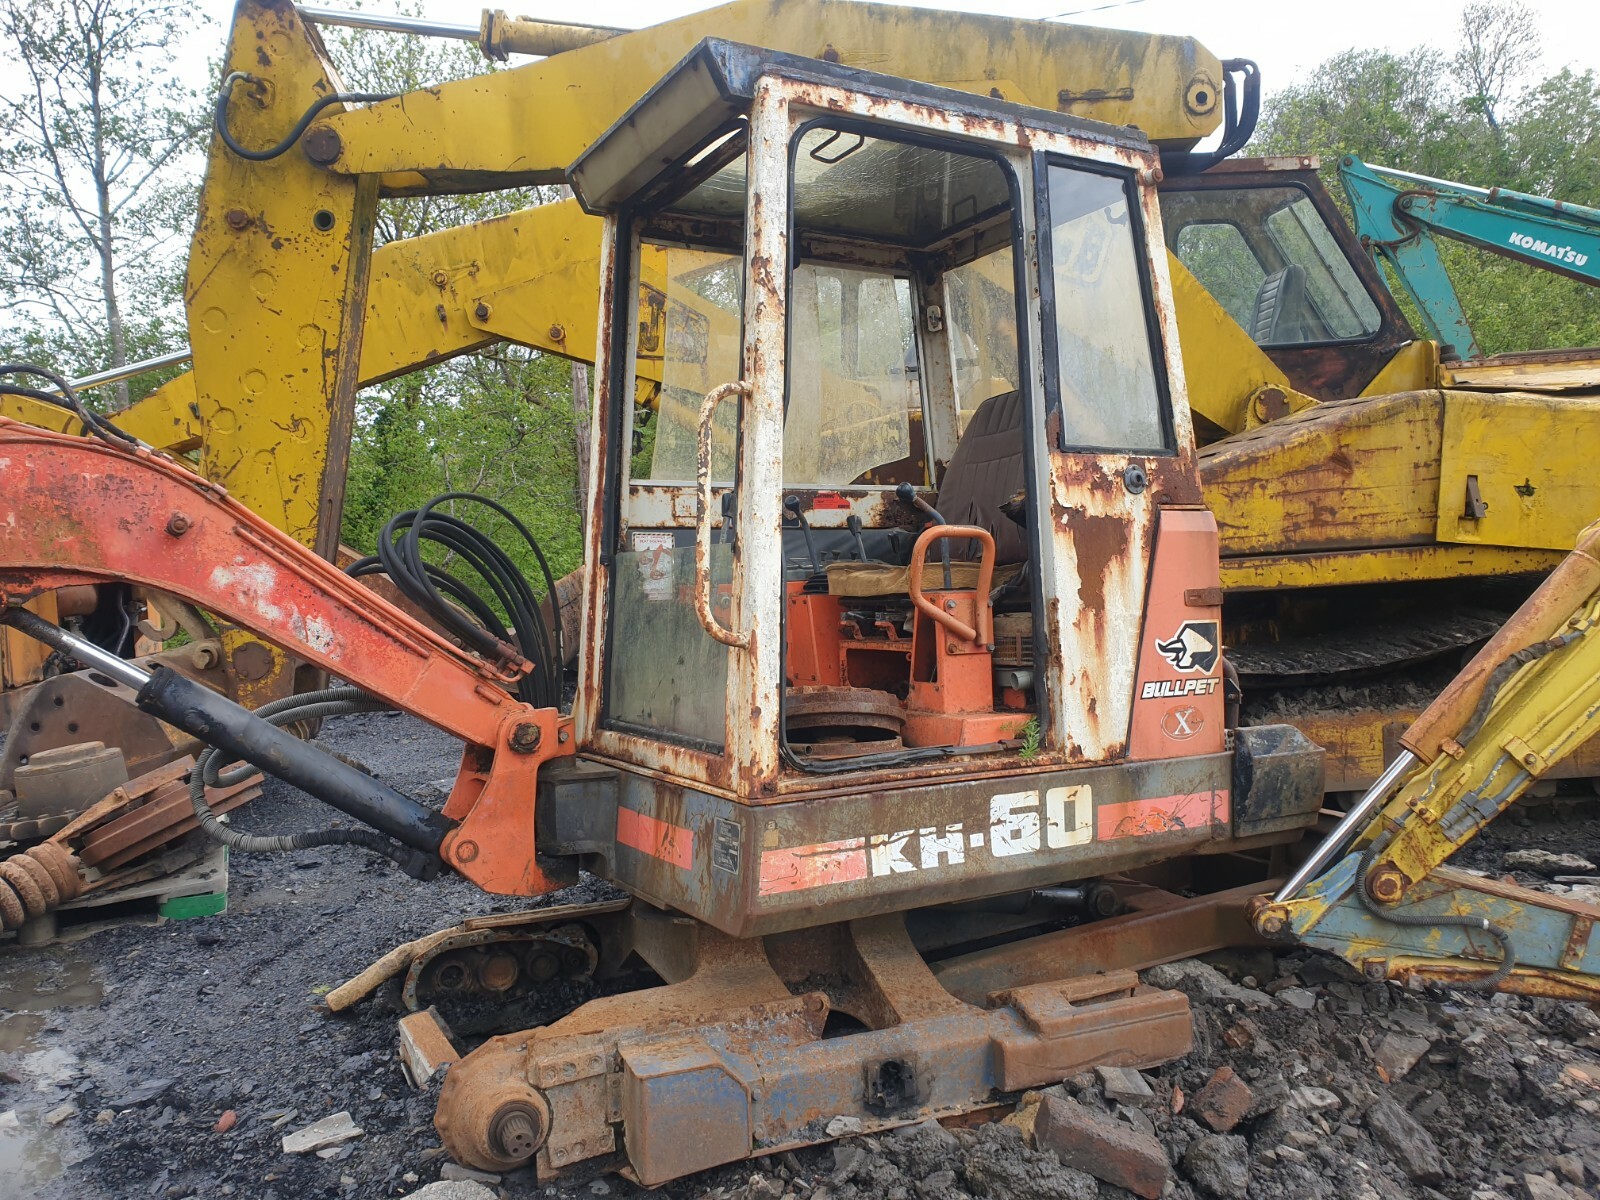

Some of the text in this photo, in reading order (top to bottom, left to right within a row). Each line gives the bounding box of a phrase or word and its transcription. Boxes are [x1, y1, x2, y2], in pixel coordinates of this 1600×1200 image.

[1508, 232, 1589, 266] KOMATSU
[1141, 678, 1220, 700] BULLPET
[1173, 707, 1194, 735] X
[870, 784, 1093, 878] KH-60
